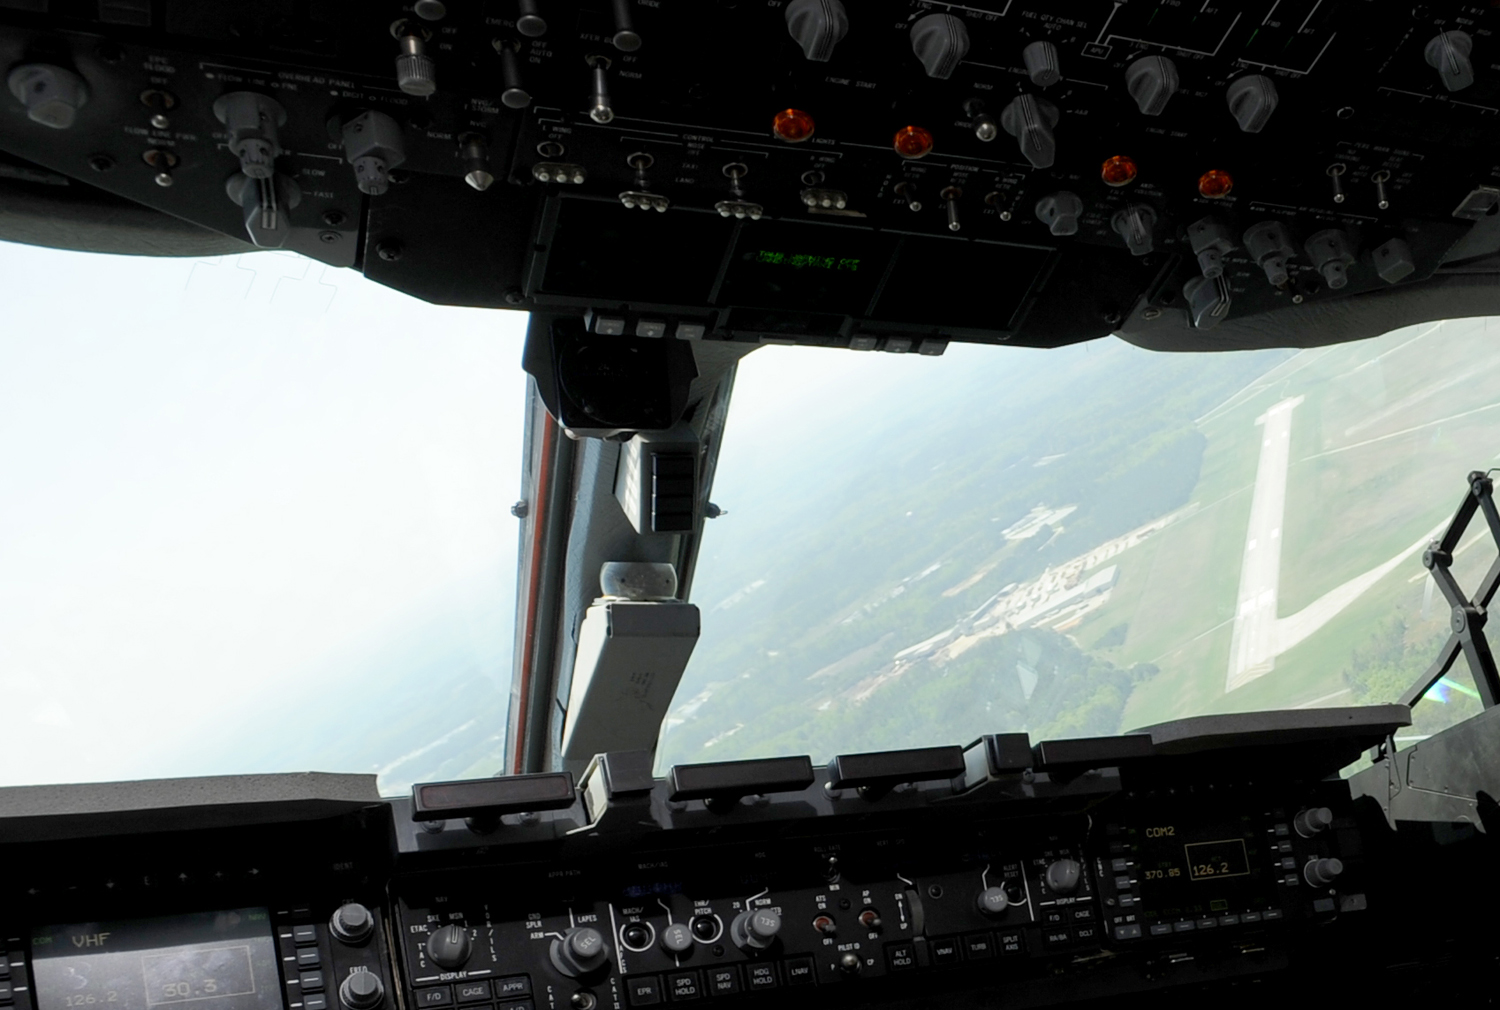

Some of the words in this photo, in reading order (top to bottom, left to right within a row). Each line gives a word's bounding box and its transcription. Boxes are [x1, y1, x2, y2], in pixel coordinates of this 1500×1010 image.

[1022, 11, 1037, 21] FUEL
[1040, 15, 1055, 23] QTY
[1076, 21, 1088, 30] SEL
[441, 27, 458, 35] OFF
[531, 40, 548, 49] OFF
[604, 37, 615, 46] BU
[439, 43, 454, 51] ON
[530, 48, 553, 58] AUTO
[622, 56, 639, 64] OFF
[619, 70, 643, 80] NORM
[277, 71, 325, 86] OVERHEAD
[328, 78, 356, 90] PANEL
[342, 90, 365, 101] DIGIT
[427, 131, 452, 141] NORM
[682, 133, 715, 145] CONTROL
[812, 137, 837, 147] LIGHTS
[313, 191, 335, 200] FAST
[1146, 826, 1176, 839] COM2
[1193, 862, 1230, 877] 126.2
[577, 914, 598, 924] LAPES
[410, 924, 428, 934] ETAC
[525, 920, 543, 930] SPLR
[71, 931, 111, 949] VHF
[530, 931, 545, 940] ARM
[581, 935, 597, 950] SEL
[894, 949, 907, 958] ALT
[893, 957, 912, 966] HOLD
[440, 970, 468, 981] DISPLAY
[753, 969, 770, 978] HDG
[791, 966, 809, 977] LNAV
[716, 972, 732, 982] SPD
[752, 976, 774, 988] HOLD
[502, 982, 524, 992] APPR
[676, 978, 692, 987] SPD
[717, 981, 732, 992] NAV
[162, 978, 218, 998] 30.3
[462, 987, 484, 998] CAGE
[637, 987, 653, 997] EPR
[675, 986, 697, 997] HOLD
[66, 989, 119, 1008] 126.2
[426, 992, 442, 1001] F/D
